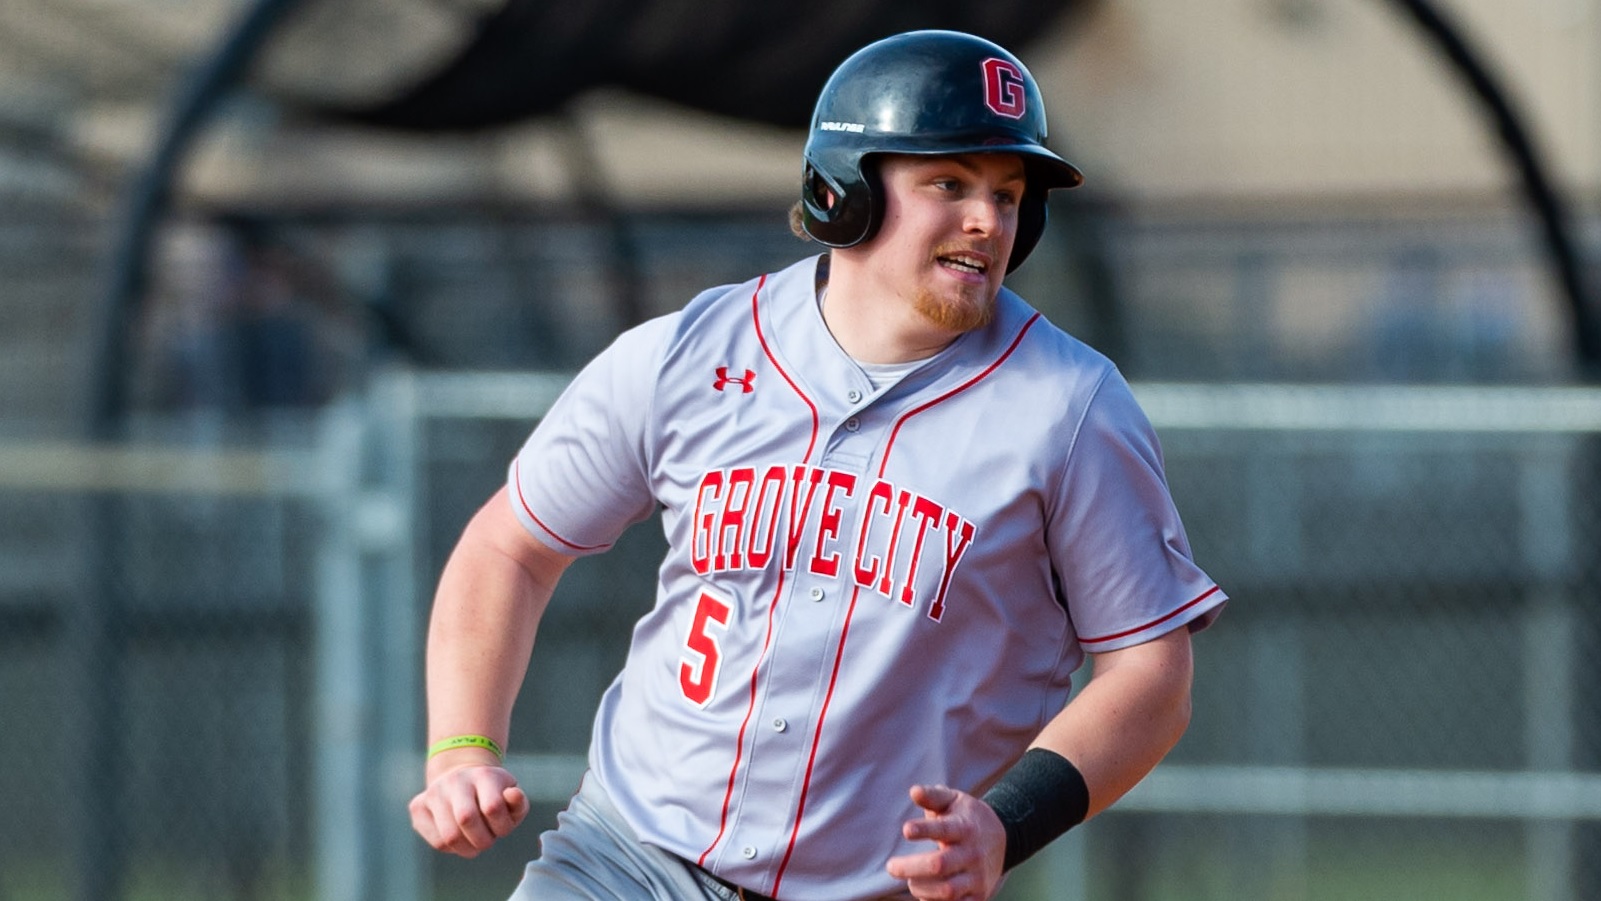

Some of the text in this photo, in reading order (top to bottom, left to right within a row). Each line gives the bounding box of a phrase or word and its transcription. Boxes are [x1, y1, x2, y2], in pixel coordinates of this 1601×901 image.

[982, 57, 1025, 119] G
[691, 464, 976, 623] GROVE CITY
[679, 586, 733, 709] 5
